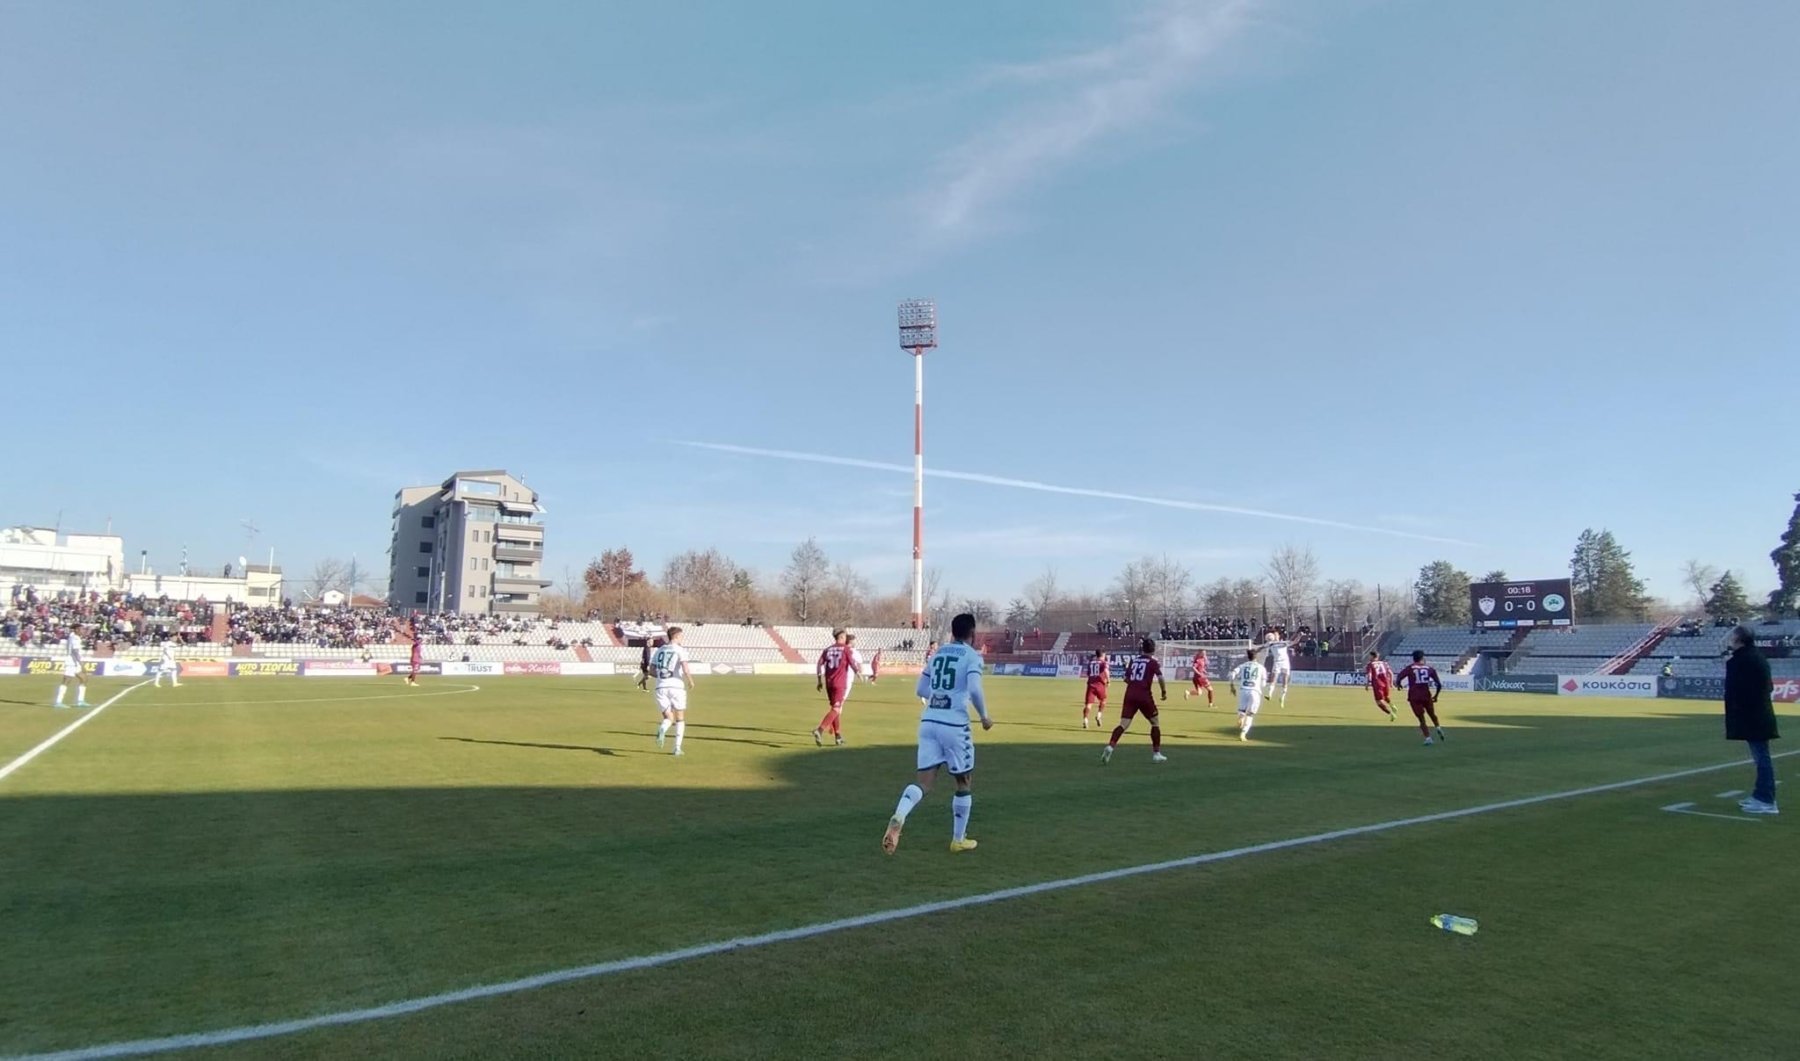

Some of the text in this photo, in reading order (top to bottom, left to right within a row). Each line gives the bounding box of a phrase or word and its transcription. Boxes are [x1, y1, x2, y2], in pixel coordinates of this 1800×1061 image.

[1504, 601, 1514, 612] 0
[1526, 600, 1536, 611] 0
[657, 650, 675, 669] 97
[931, 656, 959, 690] 35
[1130, 662, 1147, 681] 33
[1243, 666, 1259, 680] 64
[1413, 669, 1429, 684] 12
